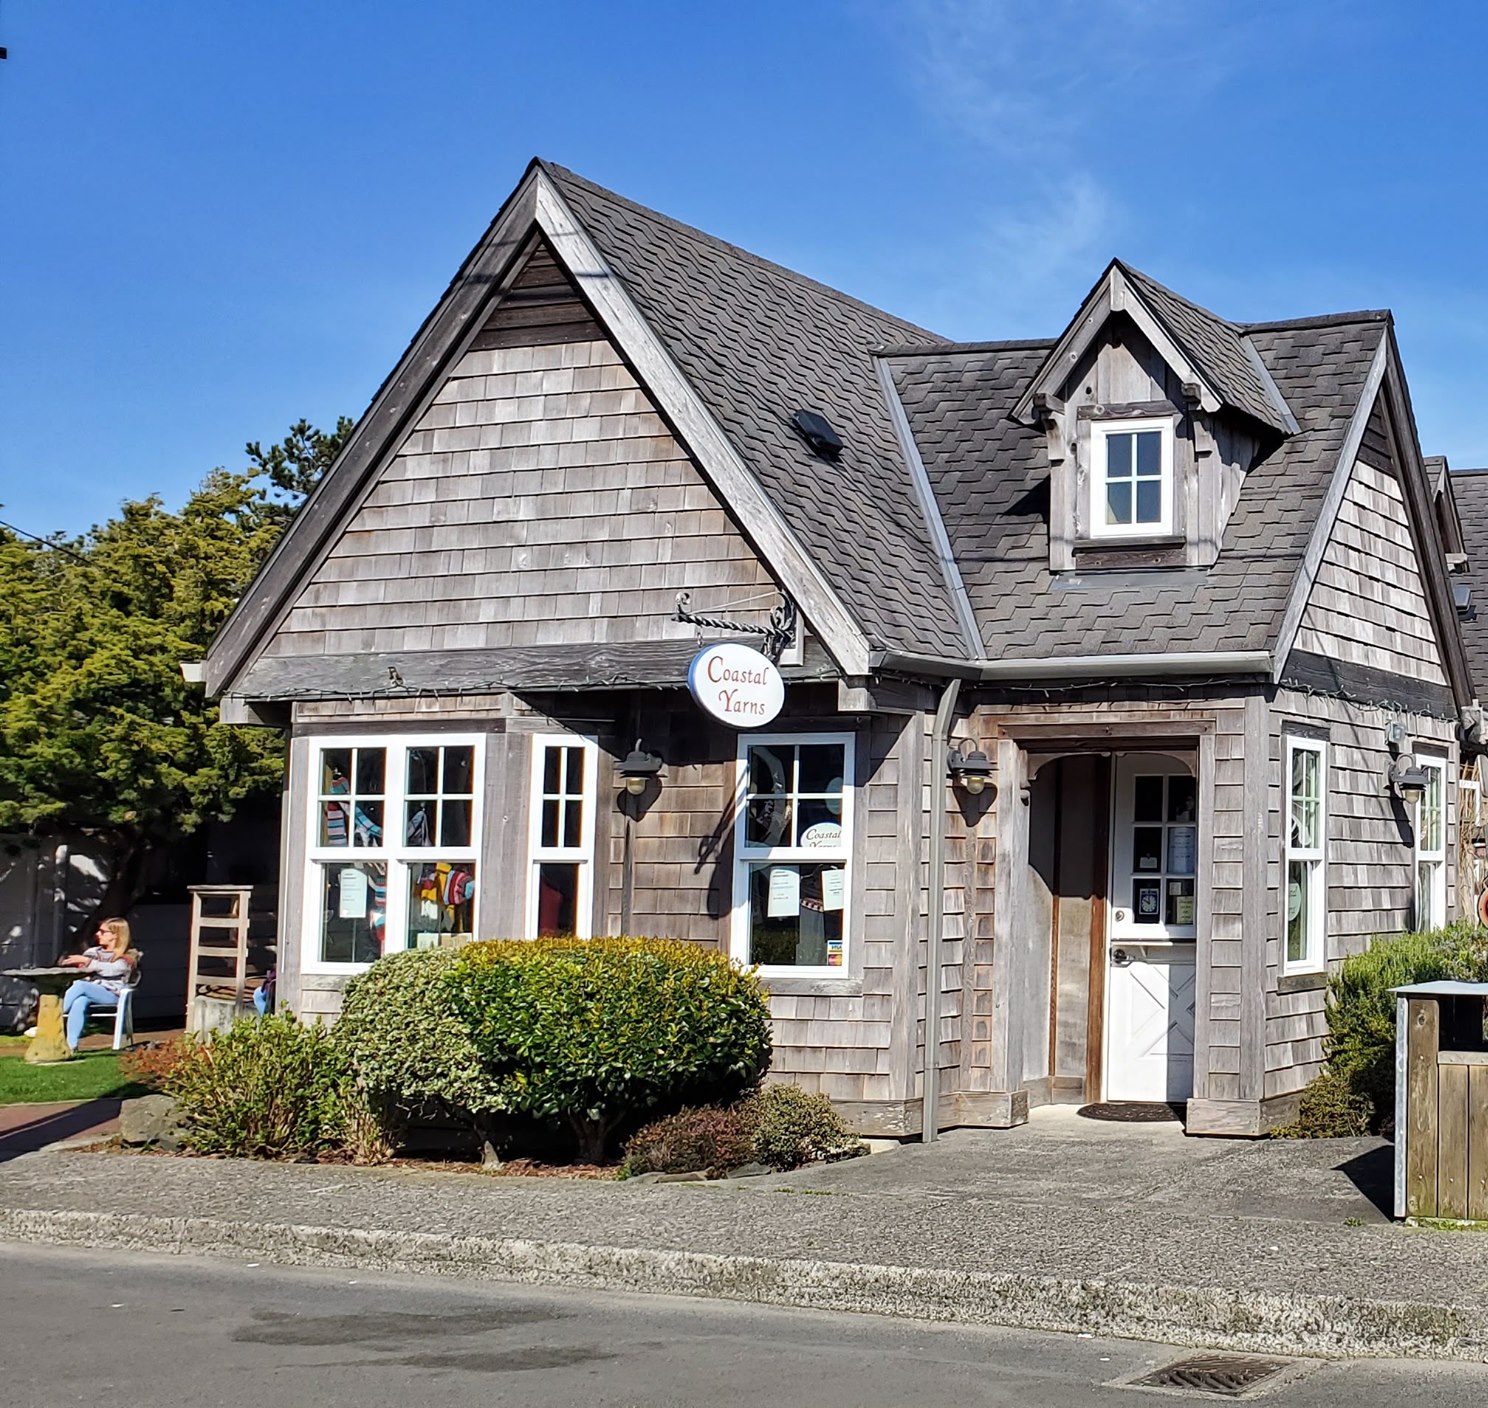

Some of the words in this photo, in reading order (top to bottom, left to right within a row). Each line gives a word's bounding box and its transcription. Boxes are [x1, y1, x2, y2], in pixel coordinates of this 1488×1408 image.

[707, 656, 769, 686] Coastal
[718, 689, 765, 715] Yarns
[806, 828, 841, 841] Coastal
